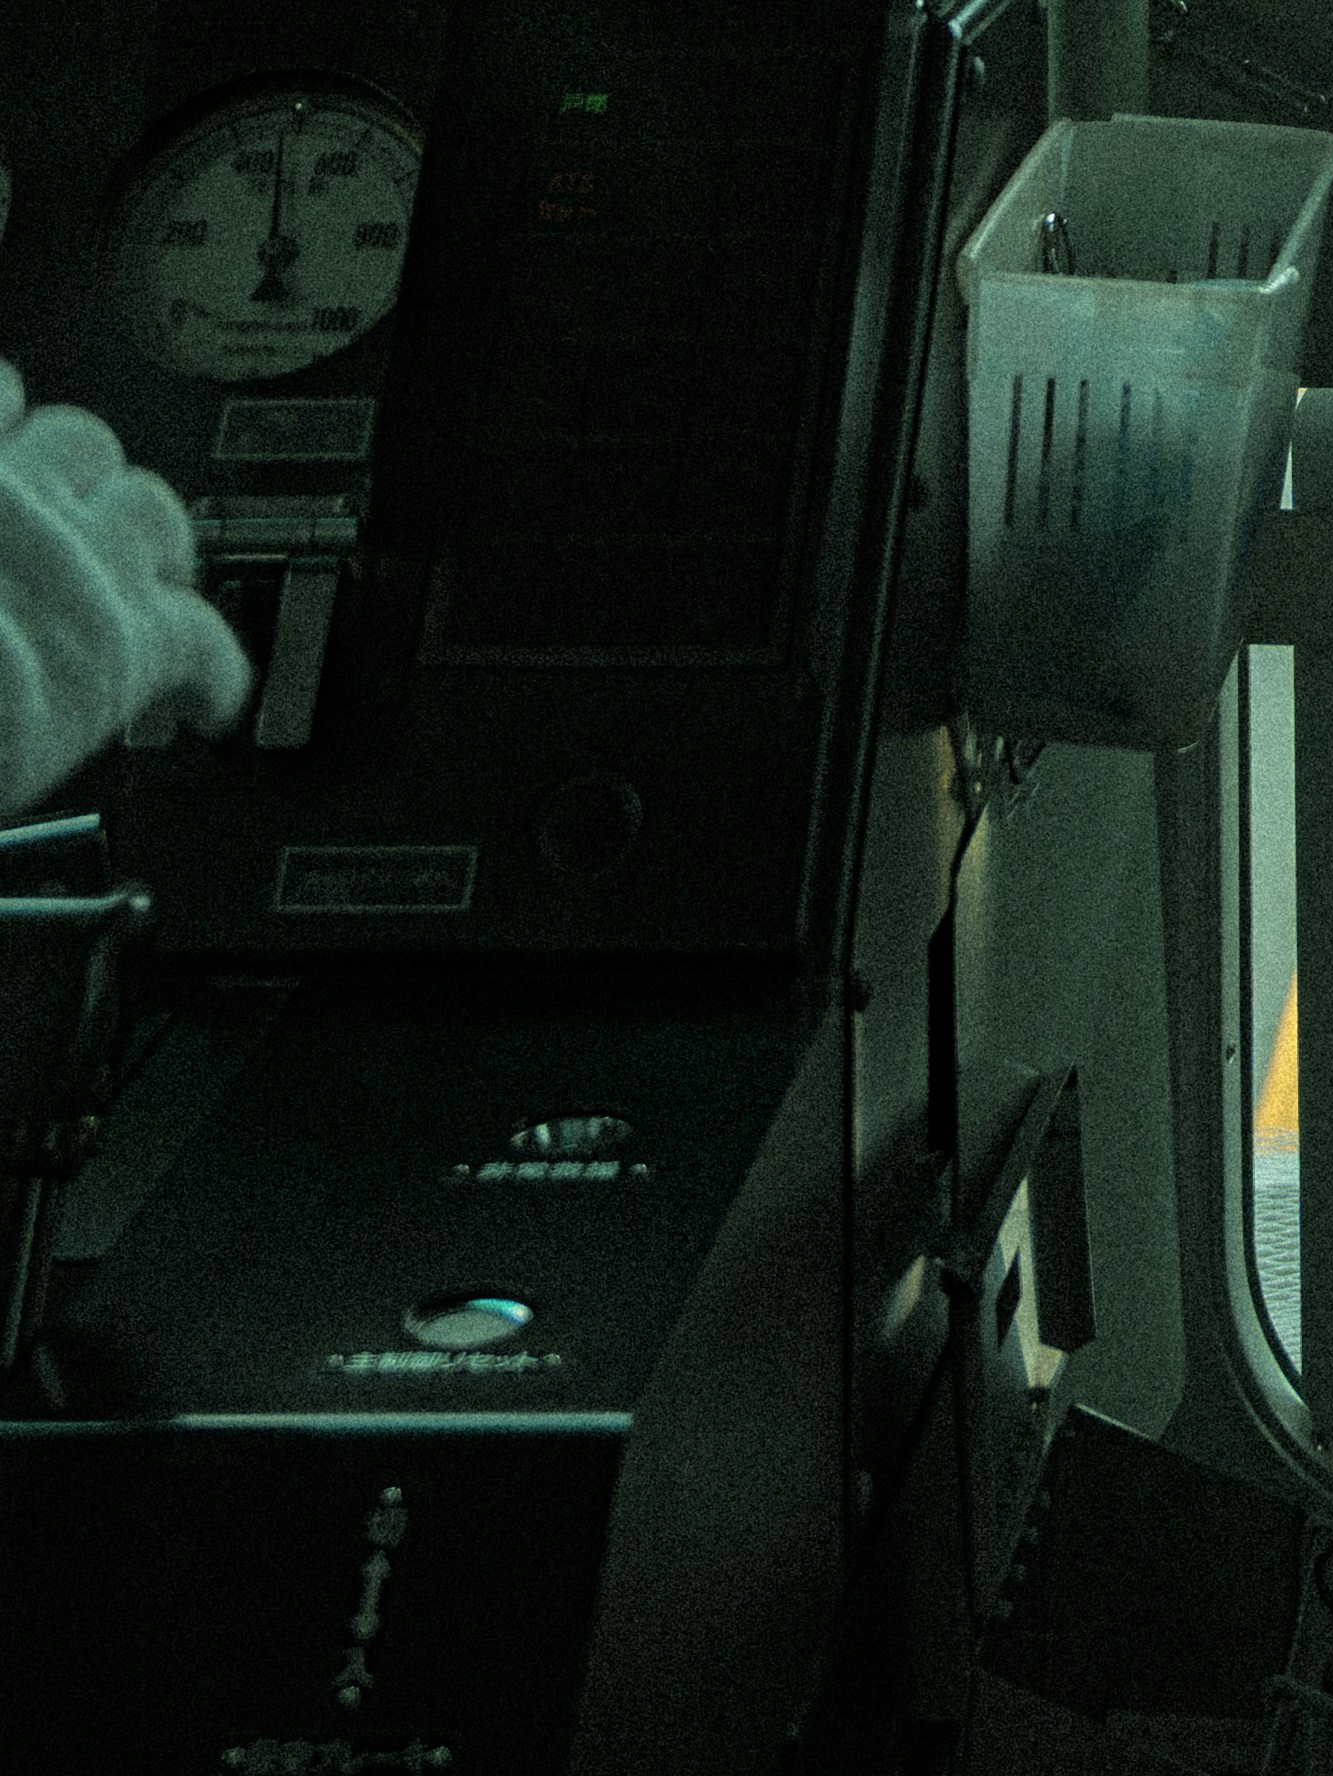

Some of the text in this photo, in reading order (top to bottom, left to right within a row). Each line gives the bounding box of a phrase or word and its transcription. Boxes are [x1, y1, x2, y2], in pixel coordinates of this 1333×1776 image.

[231, 151, 276, 174] 400
[314, 151, 358, 176] 600
[162, 220, 208, 247] 200
